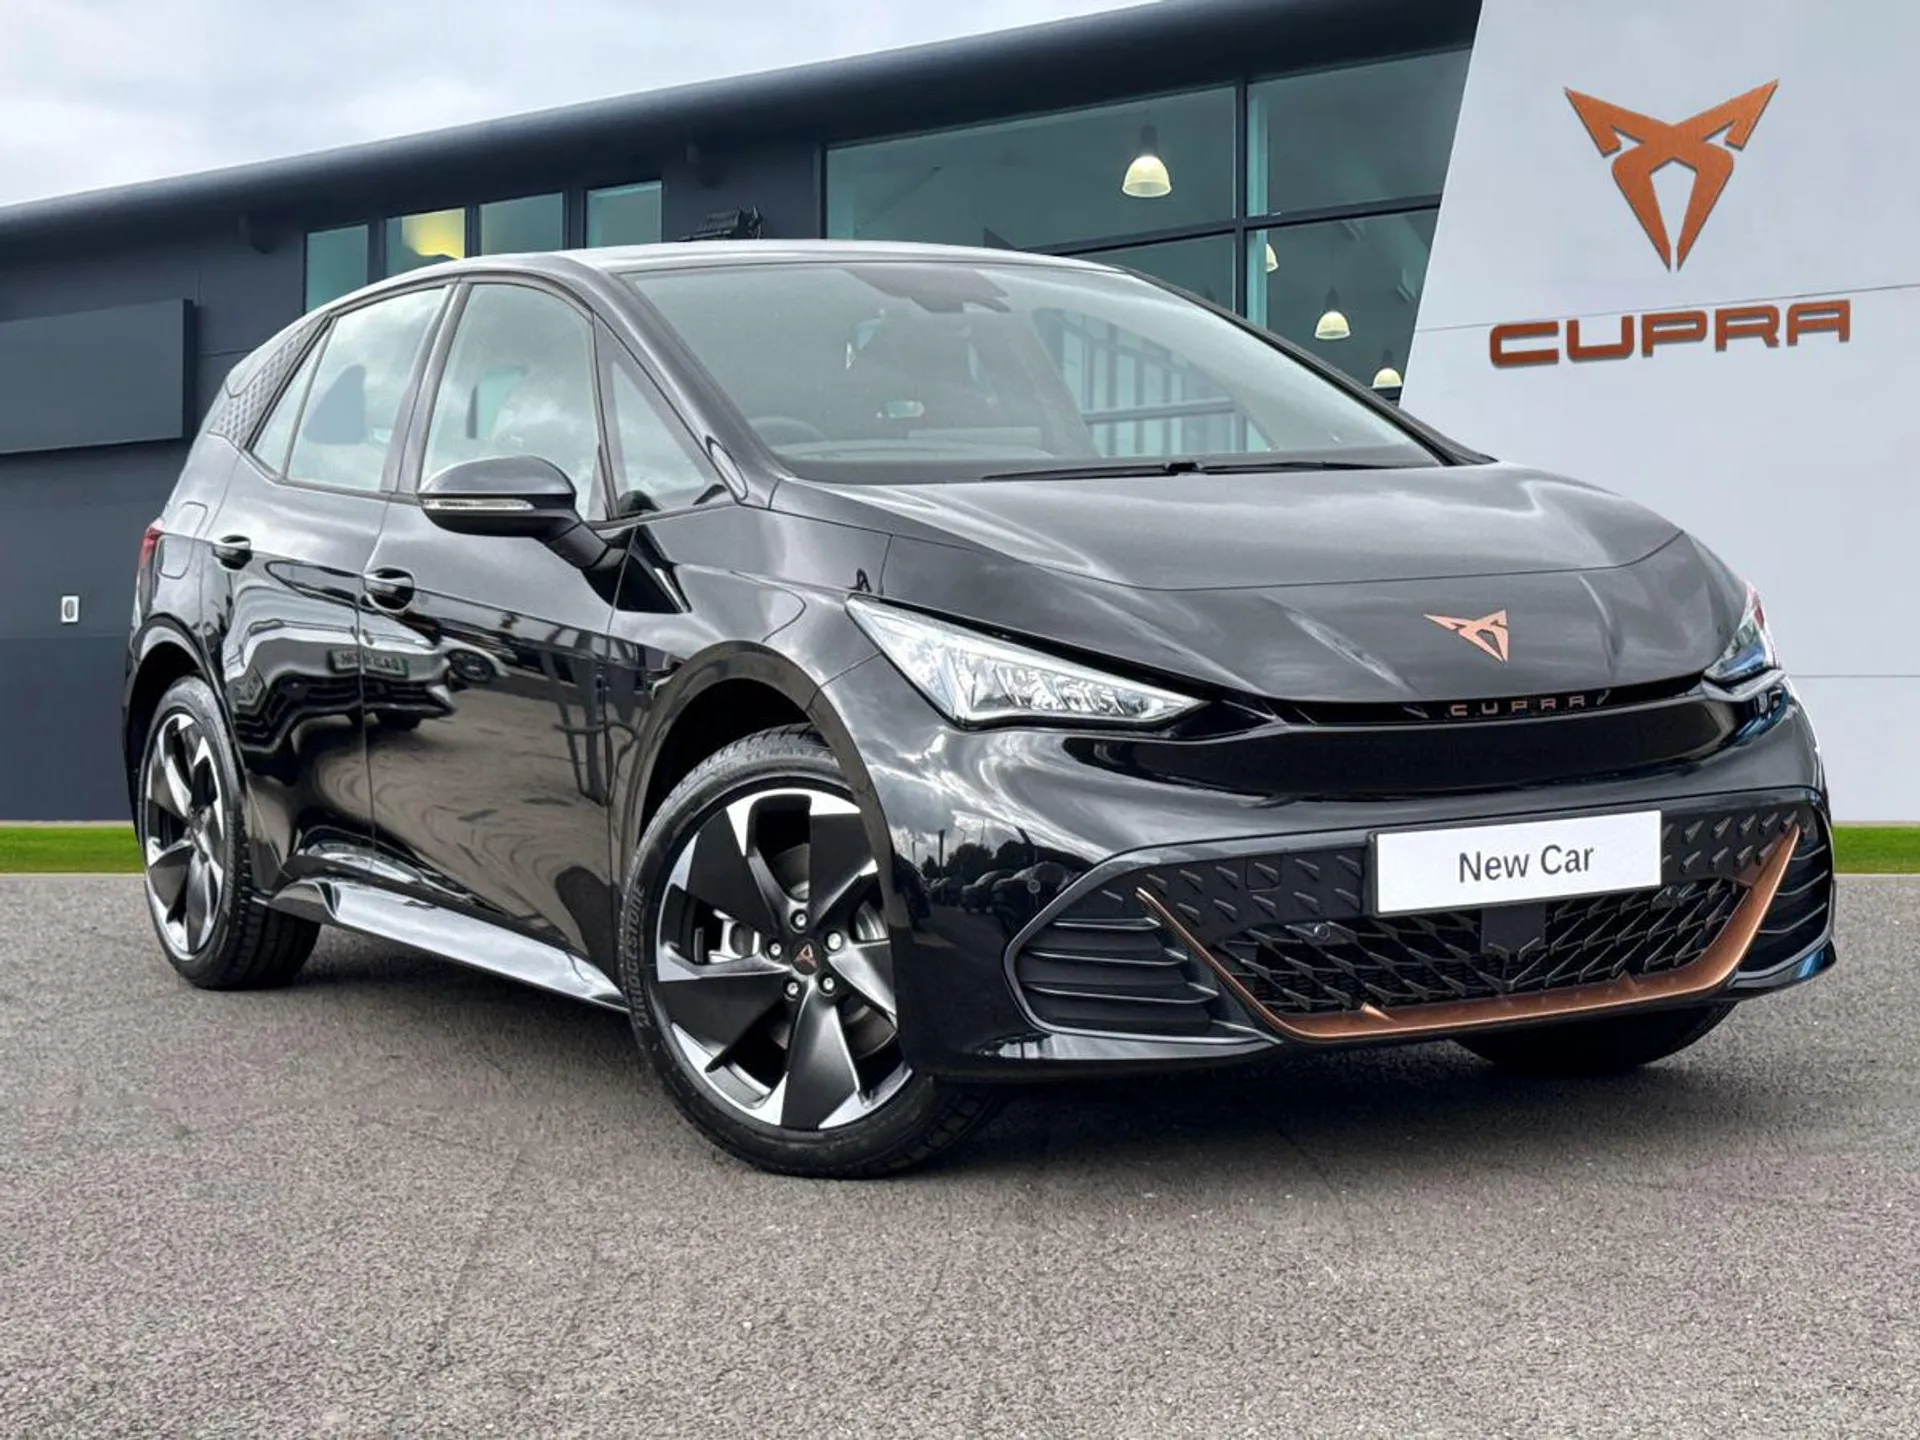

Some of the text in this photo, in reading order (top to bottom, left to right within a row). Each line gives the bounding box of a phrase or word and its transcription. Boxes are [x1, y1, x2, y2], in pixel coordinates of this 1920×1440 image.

[1490, 300, 1851, 369] CUPRA
[1450, 694, 1585, 717] CUPRA
[1459, 844, 1595, 883] New Car
[625, 884, 650, 1029] BRIDGESTONE
